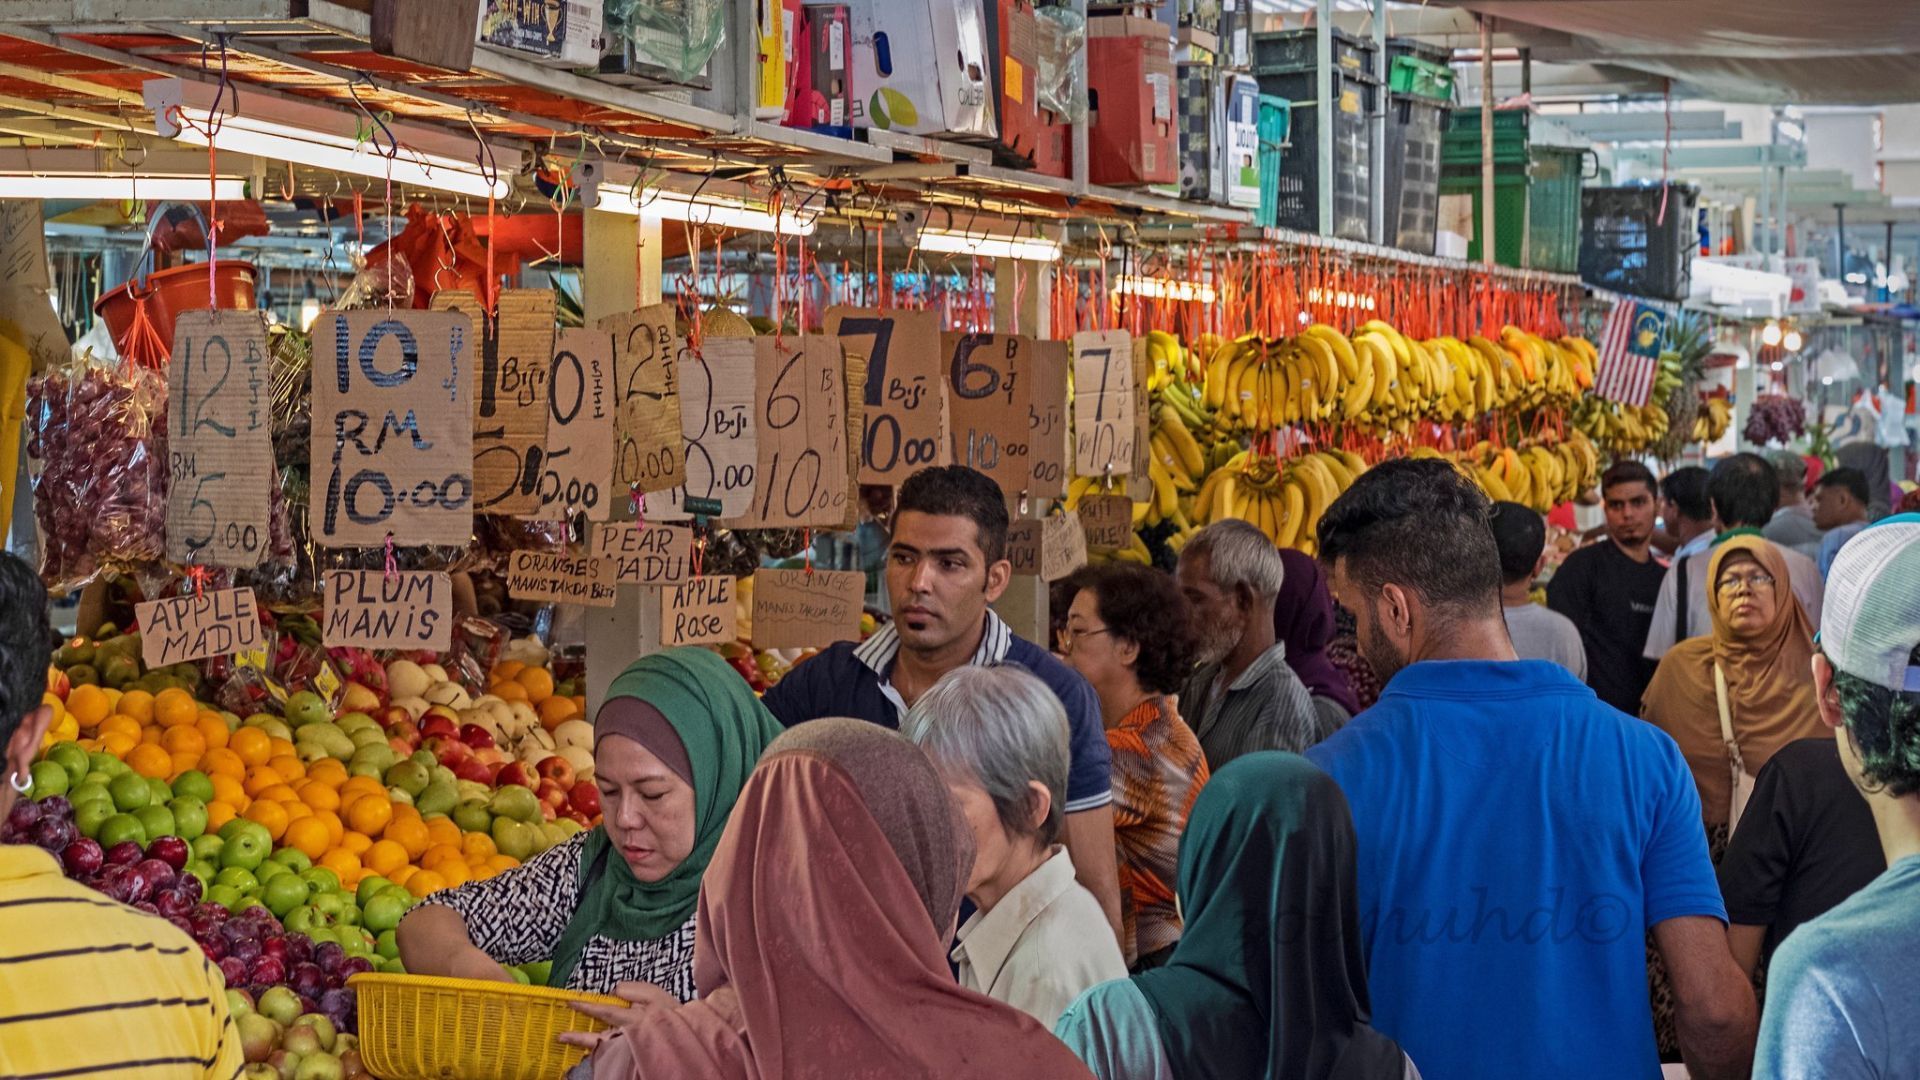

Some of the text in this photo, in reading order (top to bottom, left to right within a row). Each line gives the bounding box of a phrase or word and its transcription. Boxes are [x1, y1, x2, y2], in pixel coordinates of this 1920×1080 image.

[335, 313, 418, 394] 10
[611, 323, 663, 408] 12
[838, 318, 895, 408] 7
[950, 333, 1000, 400] 6
[180, 335, 237, 437] 12
[766, 352, 803, 429] 6
[1080, 347, 1112, 422] 7
[332, 409, 434, 465] RM
[611, 437, 675, 487] 10.00
[171, 453, 197, 483] RM
[761, 448, 846, 521] 10.00
[322, 464, 473, 536] 10.00
[517, 553, 598, 579] ORANGES
[601, 527, 674, 556] PEAR
[146, 589, 250, 635] APPLE
[329, 571, 434, 605] PLUM
[672, 577, 729, 610] APPLE
[160, 619, 256, 664] MADU
